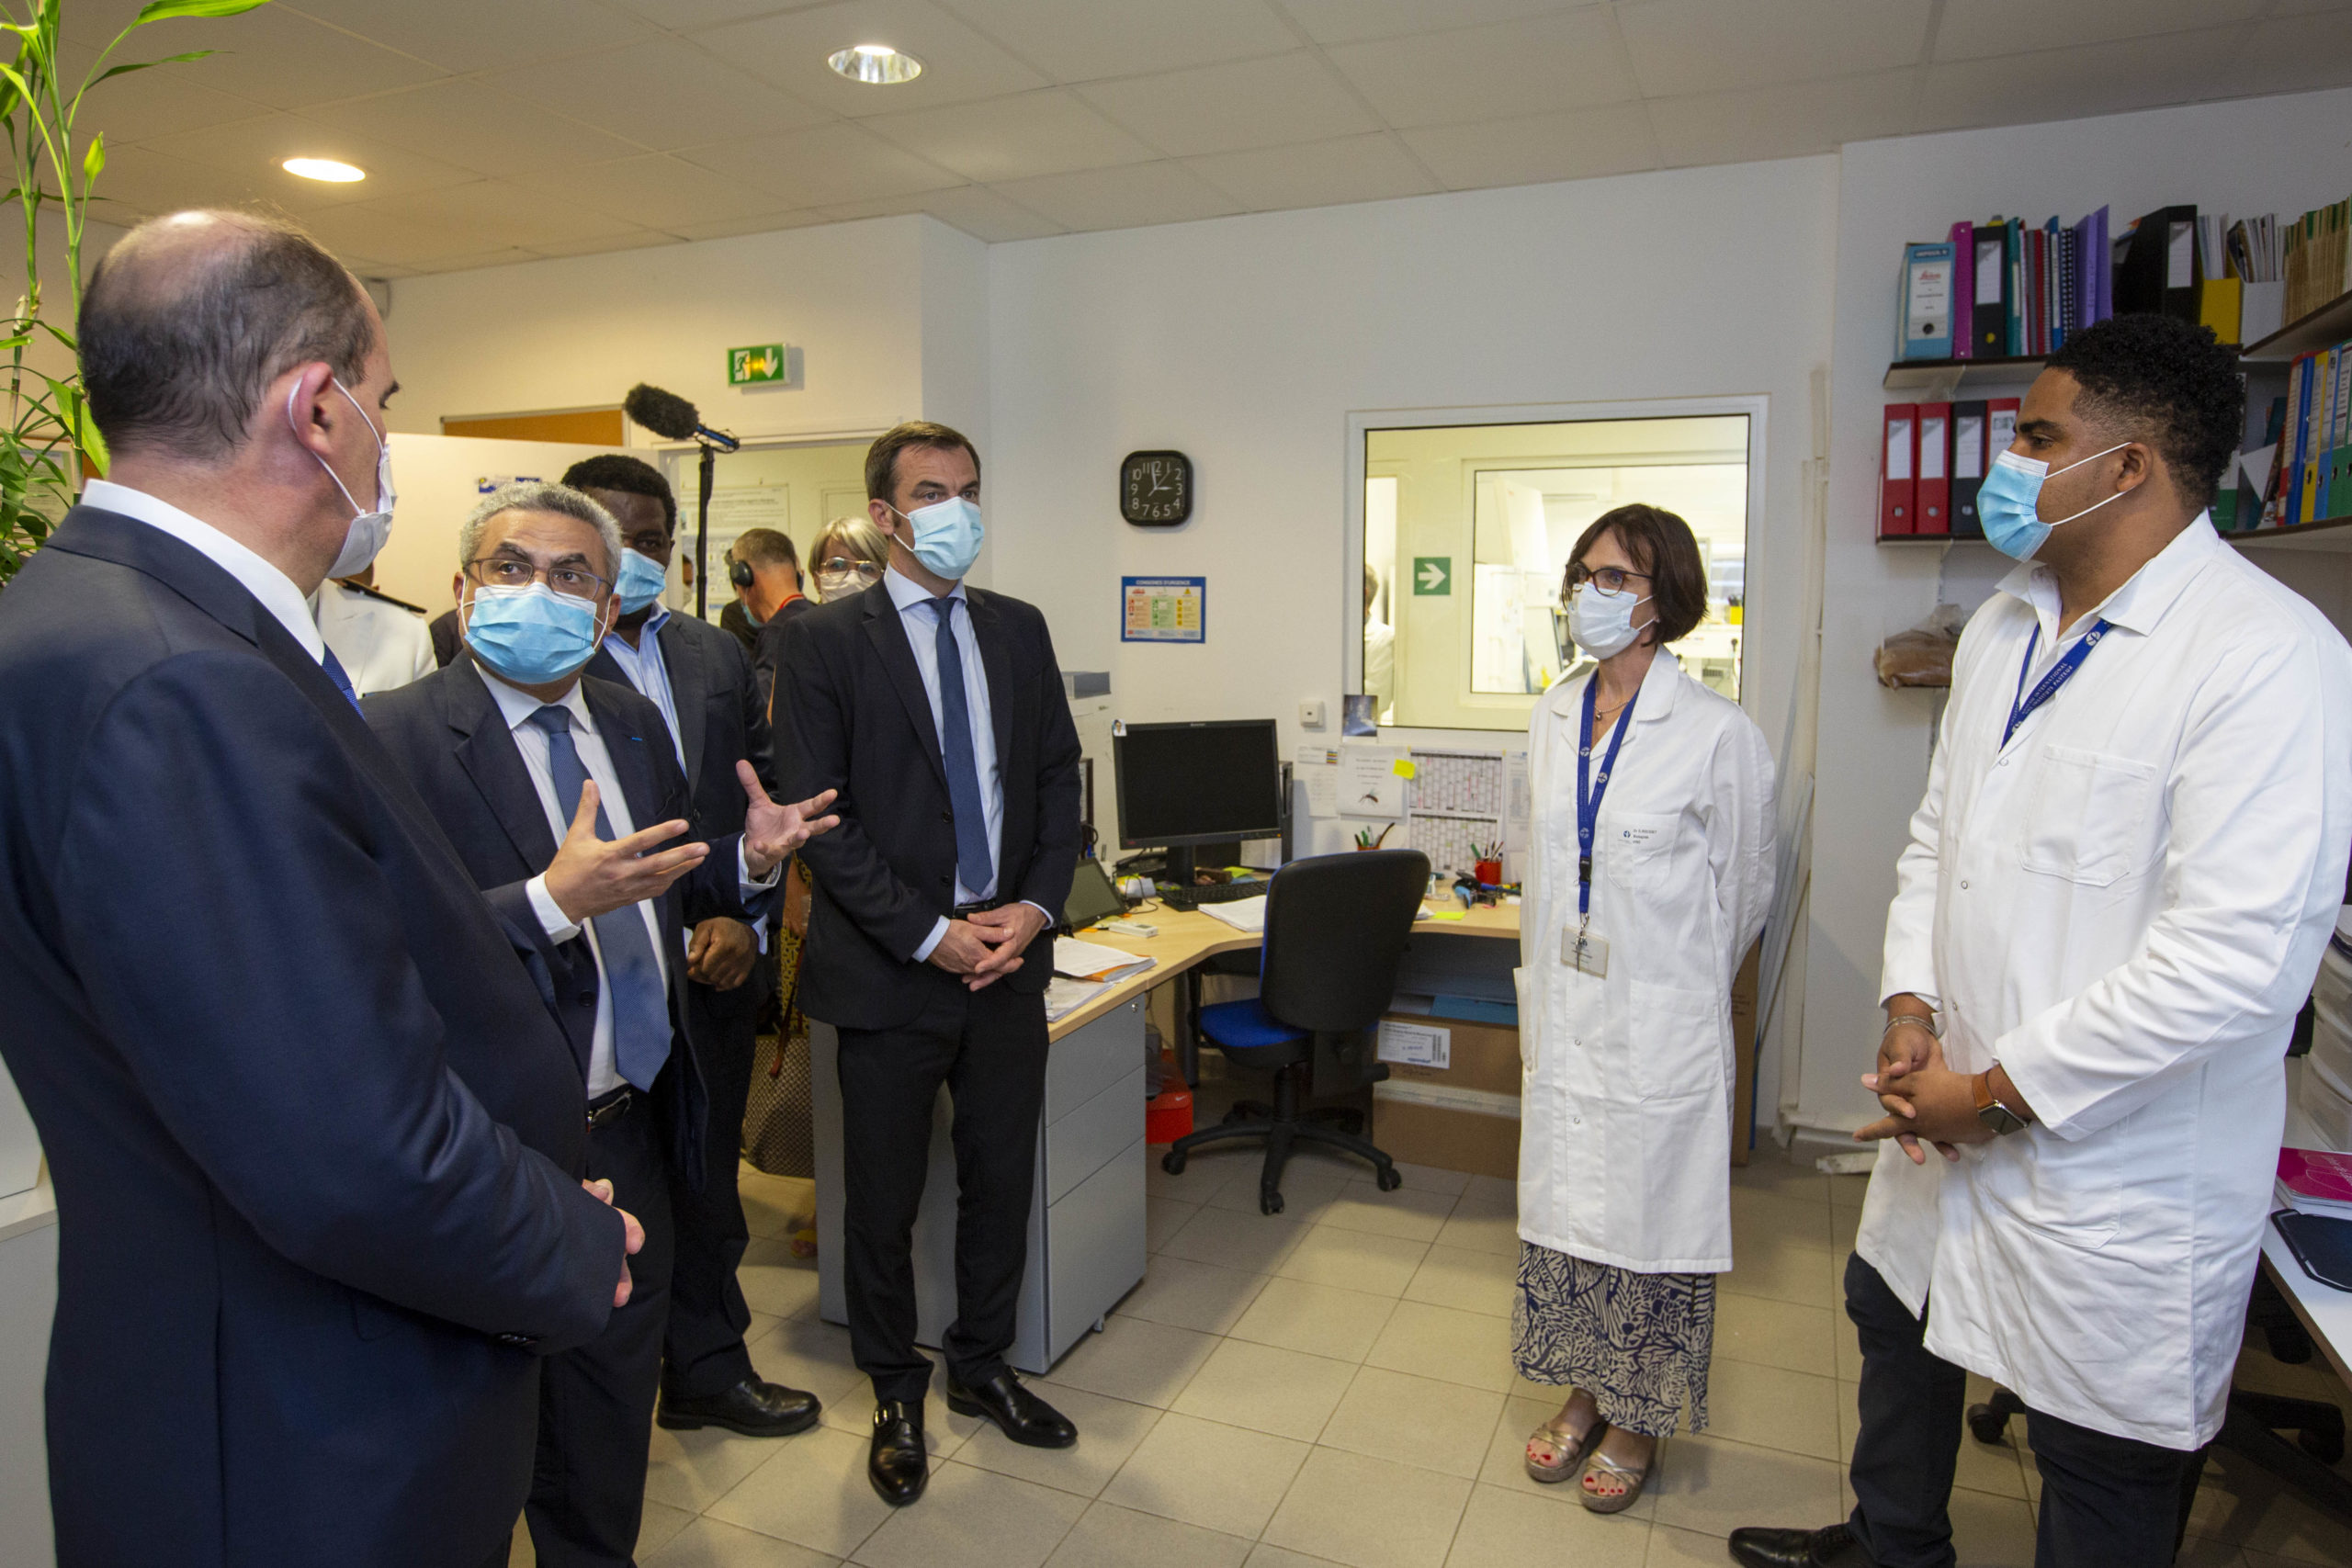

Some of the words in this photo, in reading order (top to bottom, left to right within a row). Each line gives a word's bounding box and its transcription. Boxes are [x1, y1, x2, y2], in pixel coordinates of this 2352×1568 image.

[1133, 468, 1142, 480] 10
[1143, 462, 1150, 474] 11
[1175, 468, 1182, 480] 2
[1131, 483, 1138, 495] 9
[1176, 483, 1182, 496] 3
[1132, 497, 1139, 510] 8
[1142, 503, 1150, 516] 7
[1163, 503, 1170, 516] 5
[1173, 498, 1181, 510] 4
[1152, 505, 1160, 517] 6
[2033, 662, 2067, 697] INTERNATIONAL
[2053, 665, 2074, 687] PASTEUR
